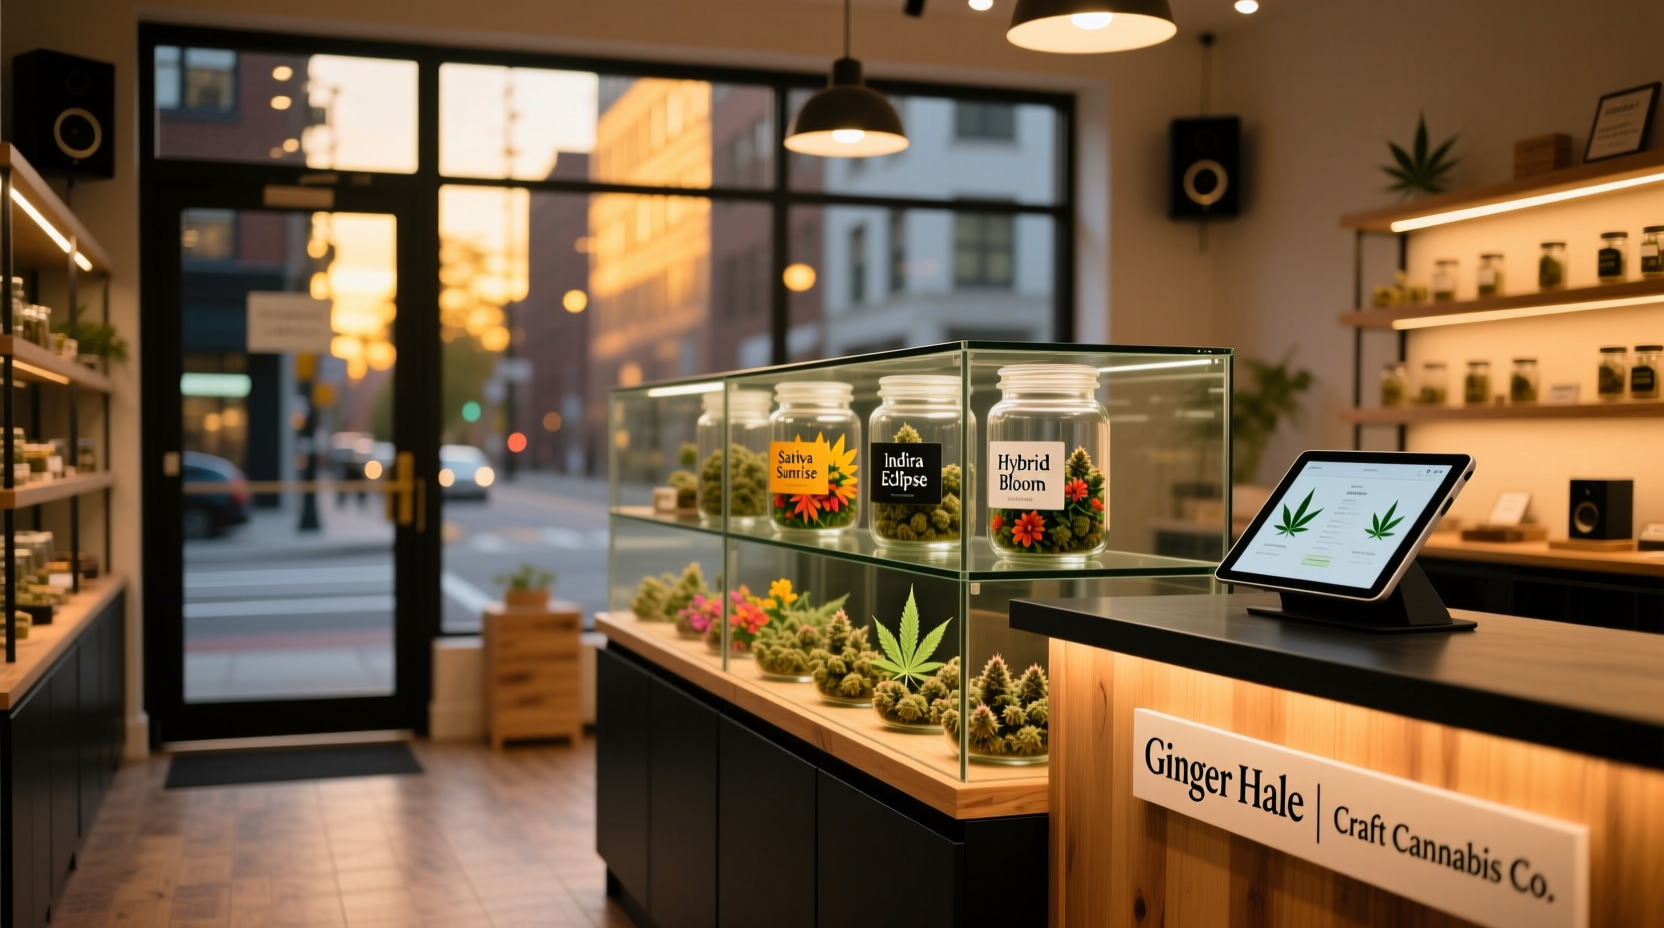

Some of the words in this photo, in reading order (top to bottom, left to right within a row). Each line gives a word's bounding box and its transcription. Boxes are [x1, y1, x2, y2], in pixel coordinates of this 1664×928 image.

[884, 451, 924, 468] Indira
[998, 453, 1051, 476] Hybrid
[776, 465, 818, 479] Sunrise
[999, 473, 1046, 492] Bloom
[1145, 737, 1233, 802] Ginger
[1238, 764, 1304, 823] Hale
[1333, 805, 1386, 847] Craft
[1392, 823, 1502, 884] Cannabis
[1509, 857, 1556, 904] Co.
